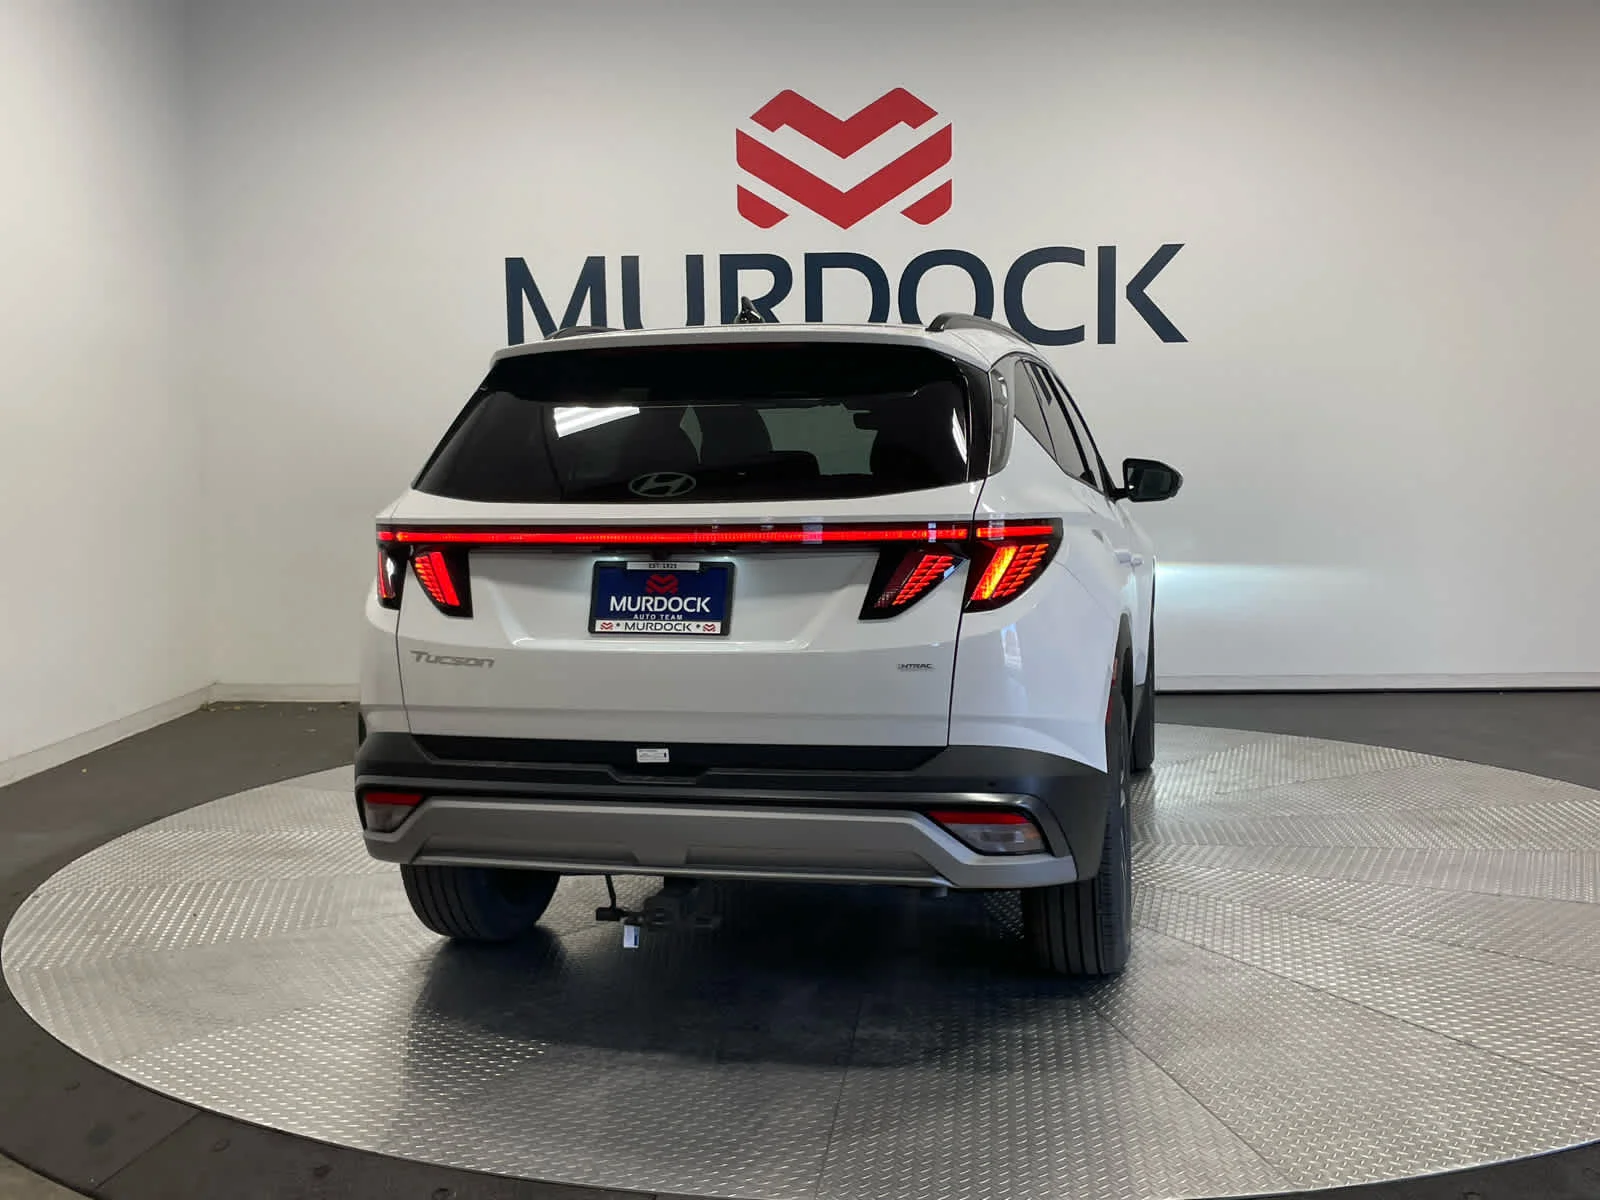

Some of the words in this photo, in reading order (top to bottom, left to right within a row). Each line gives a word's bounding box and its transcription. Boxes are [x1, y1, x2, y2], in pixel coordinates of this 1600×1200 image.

[505, 243, 1188, 346] MURDOCK
[610, 596, 711, 613] MURDOCK
[624, 622, 692, 632] MURDOCK
